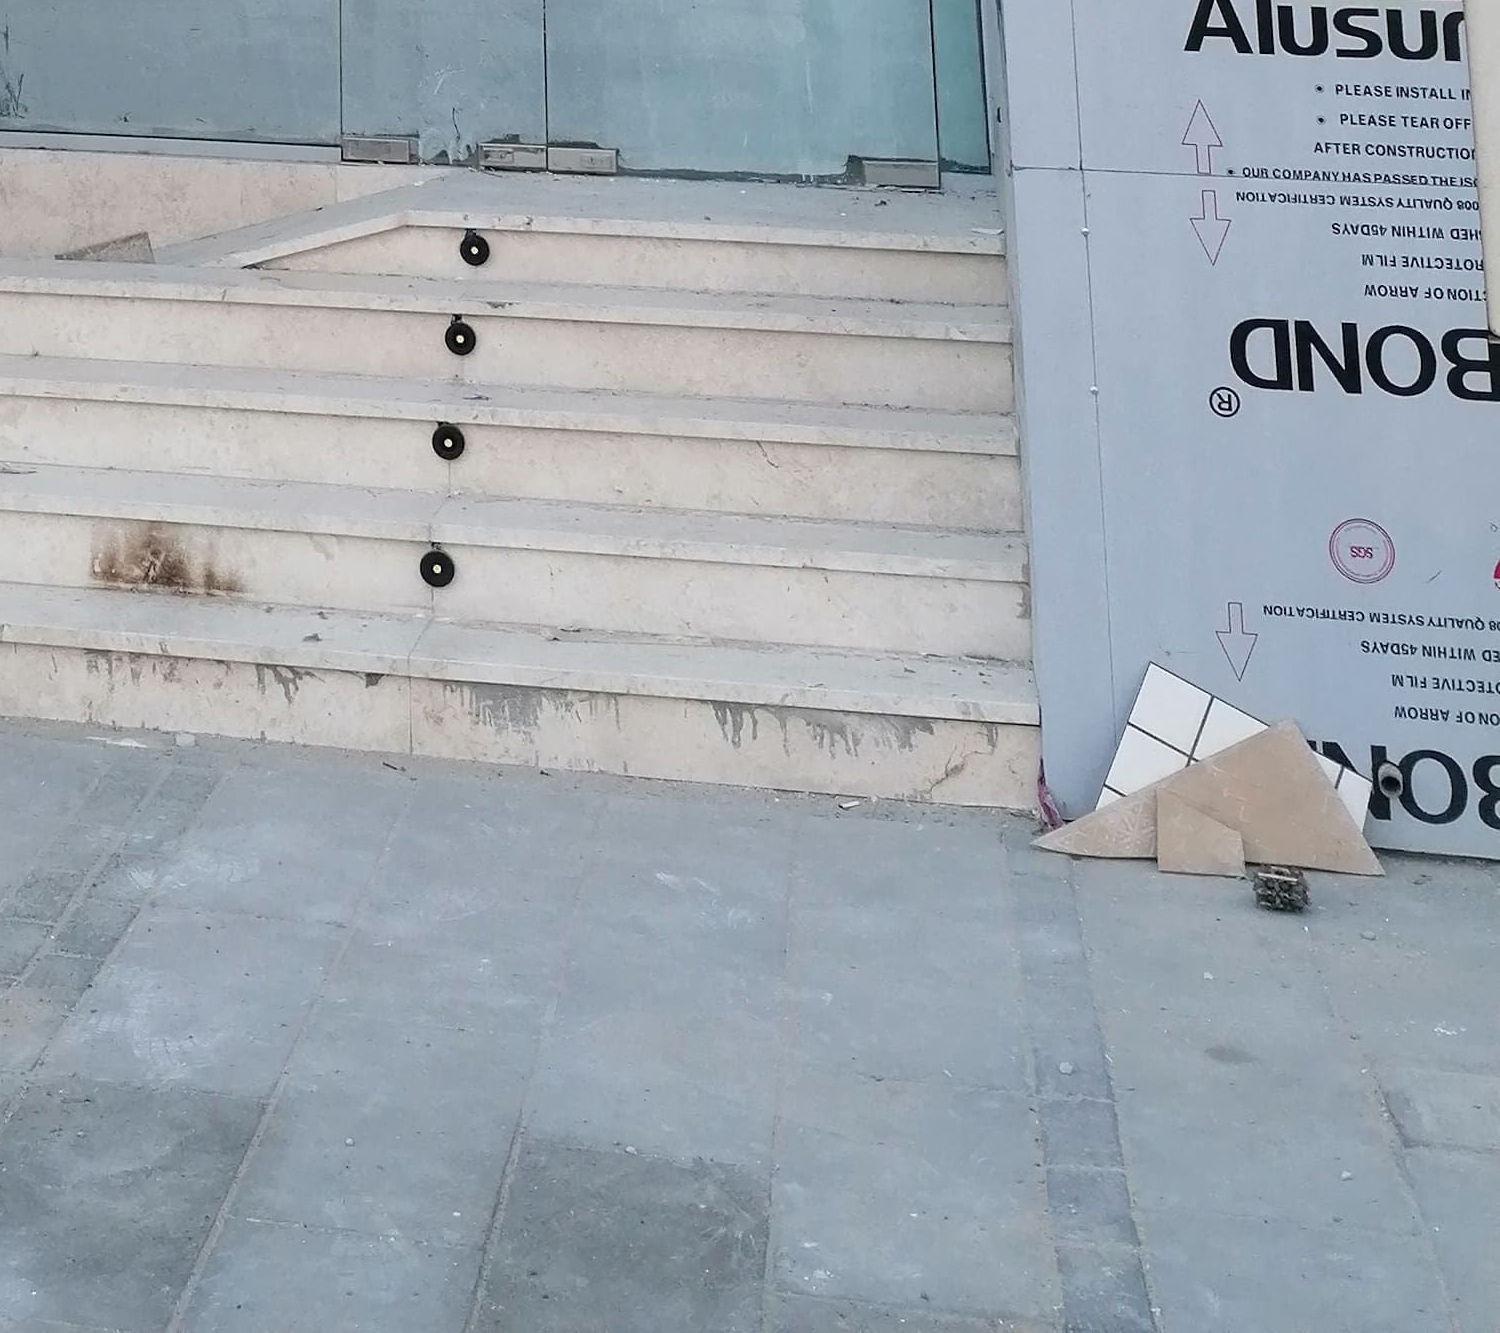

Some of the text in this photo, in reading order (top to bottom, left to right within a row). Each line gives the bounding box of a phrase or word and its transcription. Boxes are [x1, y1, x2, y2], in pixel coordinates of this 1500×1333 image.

[1335, 84, 1457, 101] PLEASE INSTALL
[1339, 113, 1472, 131] PLEASE TEAR OFF
[1314, 141, 1361, 156] AFTER
[1235, 190, 1337, 206] CERTIFICATION
[1339, 194, 1394, 209] SYSTEM
[1397, 196, 1454, 212] QUALITY
[1331, 221, 1388, 237] 45DAYS
[1391, 225, 1445, 240] WITHIN
[1361, 253, 1397, 268] FILM
[1364, 284, 1419, 299] ARROW
[1424, 286, 1445, 300] OF
[1230, 318, 1500, 403] BOND
[1263, 604, 1486, 631] QUALITY SYSTEM CERTIFICATION
[1360, 639, 1477, 661] WITHIN 45DAYS
[1391, 673, 1428, 689] FILM
[1394, 705, 1477, 724] OF ARROW
